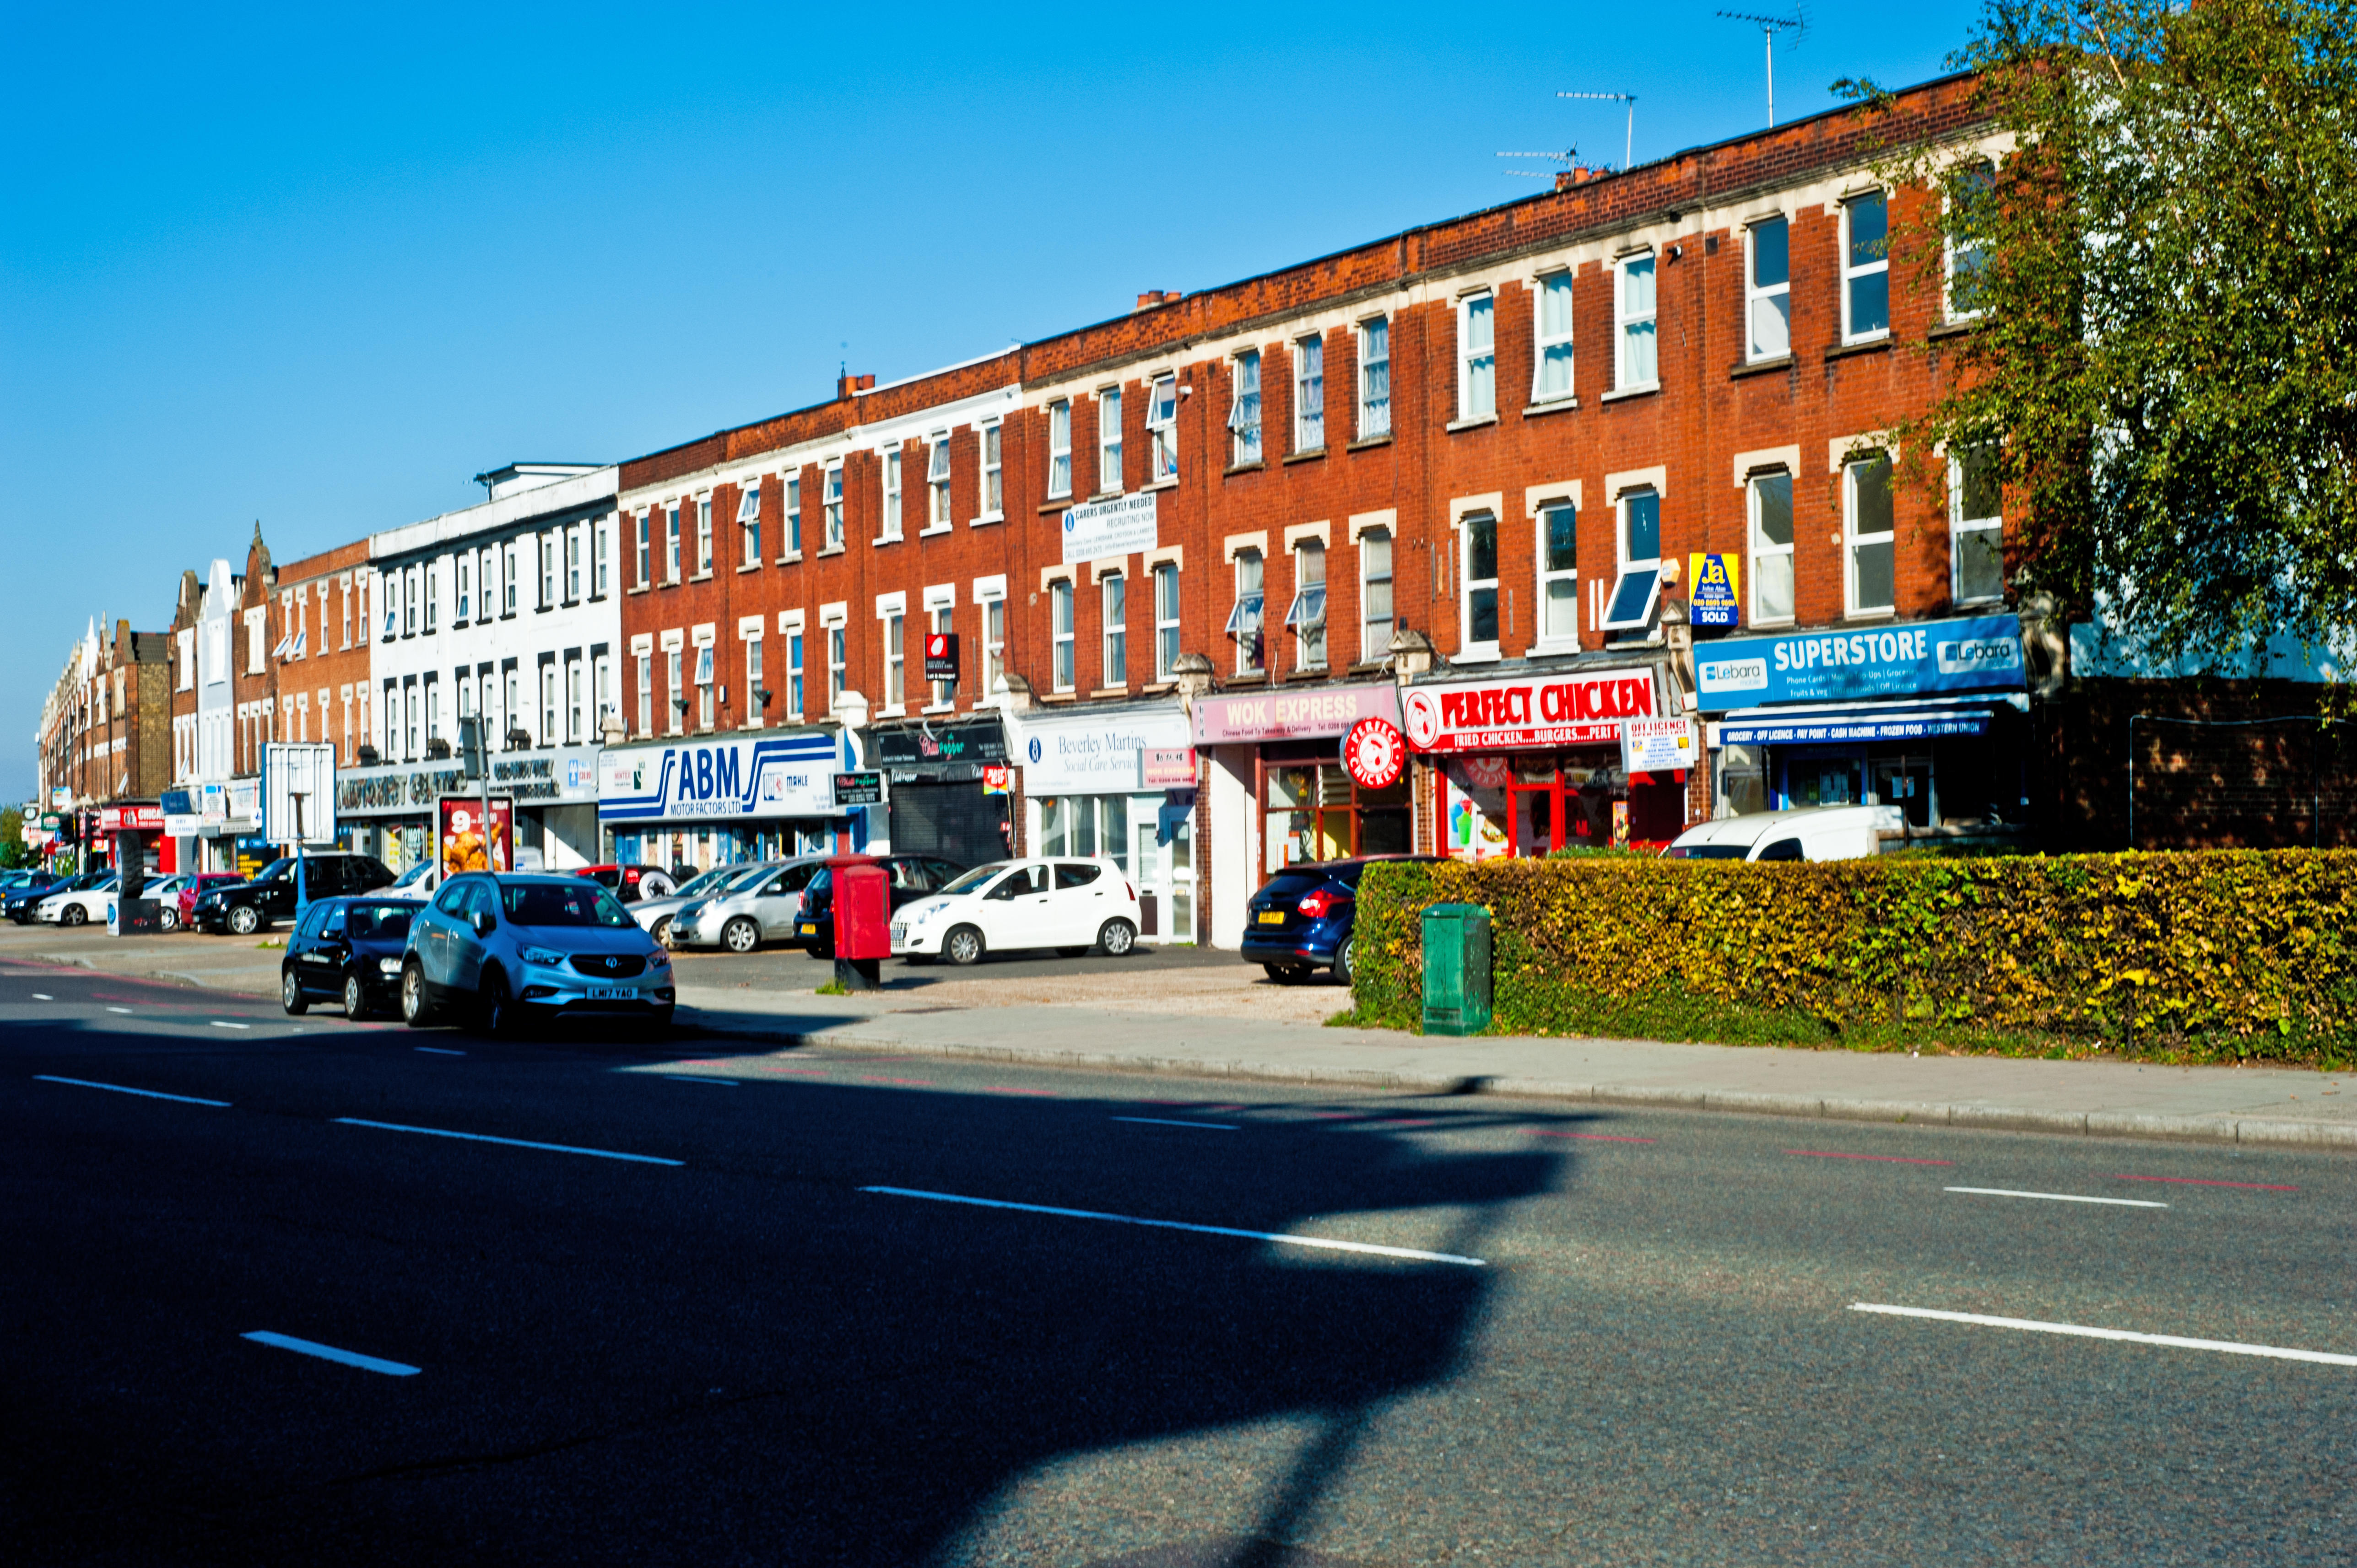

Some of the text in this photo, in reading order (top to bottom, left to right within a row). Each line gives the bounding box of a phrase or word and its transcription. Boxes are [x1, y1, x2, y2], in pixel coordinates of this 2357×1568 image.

[1076, 496, 1155, 520] CARERS URGENTLY NEEDED!
[1107, 511, 1155, 528] RECRUITING NOW
[1065, 550, 1075, 559] CALL
[1702, 611, 1728, 623] SOLD
[1774, 630, 1928, 671] SUPERSTORE
[1957, 642, 2010, 661] Lebara
[1716, 665, 1761, 679] Lebara
[1786, 676, 1806, 684] Phone
[1808, 674, 1826, 684] Cards
[1740, 678, 1761, 687] mobile
[1790, 689, 1808, 698] Fruits
[1816, 687, 1827, 698] Veg
[1880, 682, 1890, 691] Off
[1891, 681, 1917, 691] Licence
[1227, 700, 1267, 727] WOK
[1275, 694, 1357, 723] EXPRESS
[1440, 678, 1652, 727] PERFECT CHICKEN
[1222, 729, 1241, 737] Chinese
[1242, 728, 1254, 736] Food
[1262, 727, 1285, 736] Takeaway
[1292, 725, 1312, 734] Delivery
[1631, 720, 1687, 732] OFF LICENCE
[1726, 721, 1980, 742] GROCERY OFF LICENCE PAY POINT CASH MACHINE FROZEN FOOD WESTERN UNION
[1351, 720, 1401, 749] PERFECT
[1454, 733, 1479, 747] FRIED
[939, 741, 965, 755] Pepper
[1059, 731, 1146, 757] Beverley Martins
[1064, 758, 1087, 773] Social
[1089, 757, 1108, 771] Care
[1164, 766, 1195, 775] EXPRESS
[1350, 756, 1398, 786] CHICKEN
[614, 772, 631, 780] MINTEX
[678, 746, 741, 801] ABM
[786, 775, 808, 787] MAHLE
[855, 777, 878, 787] Pepper
[670, 801, 741, 817] MOTOR FACTORS LTD
[451, 810, 470, 834] 9
